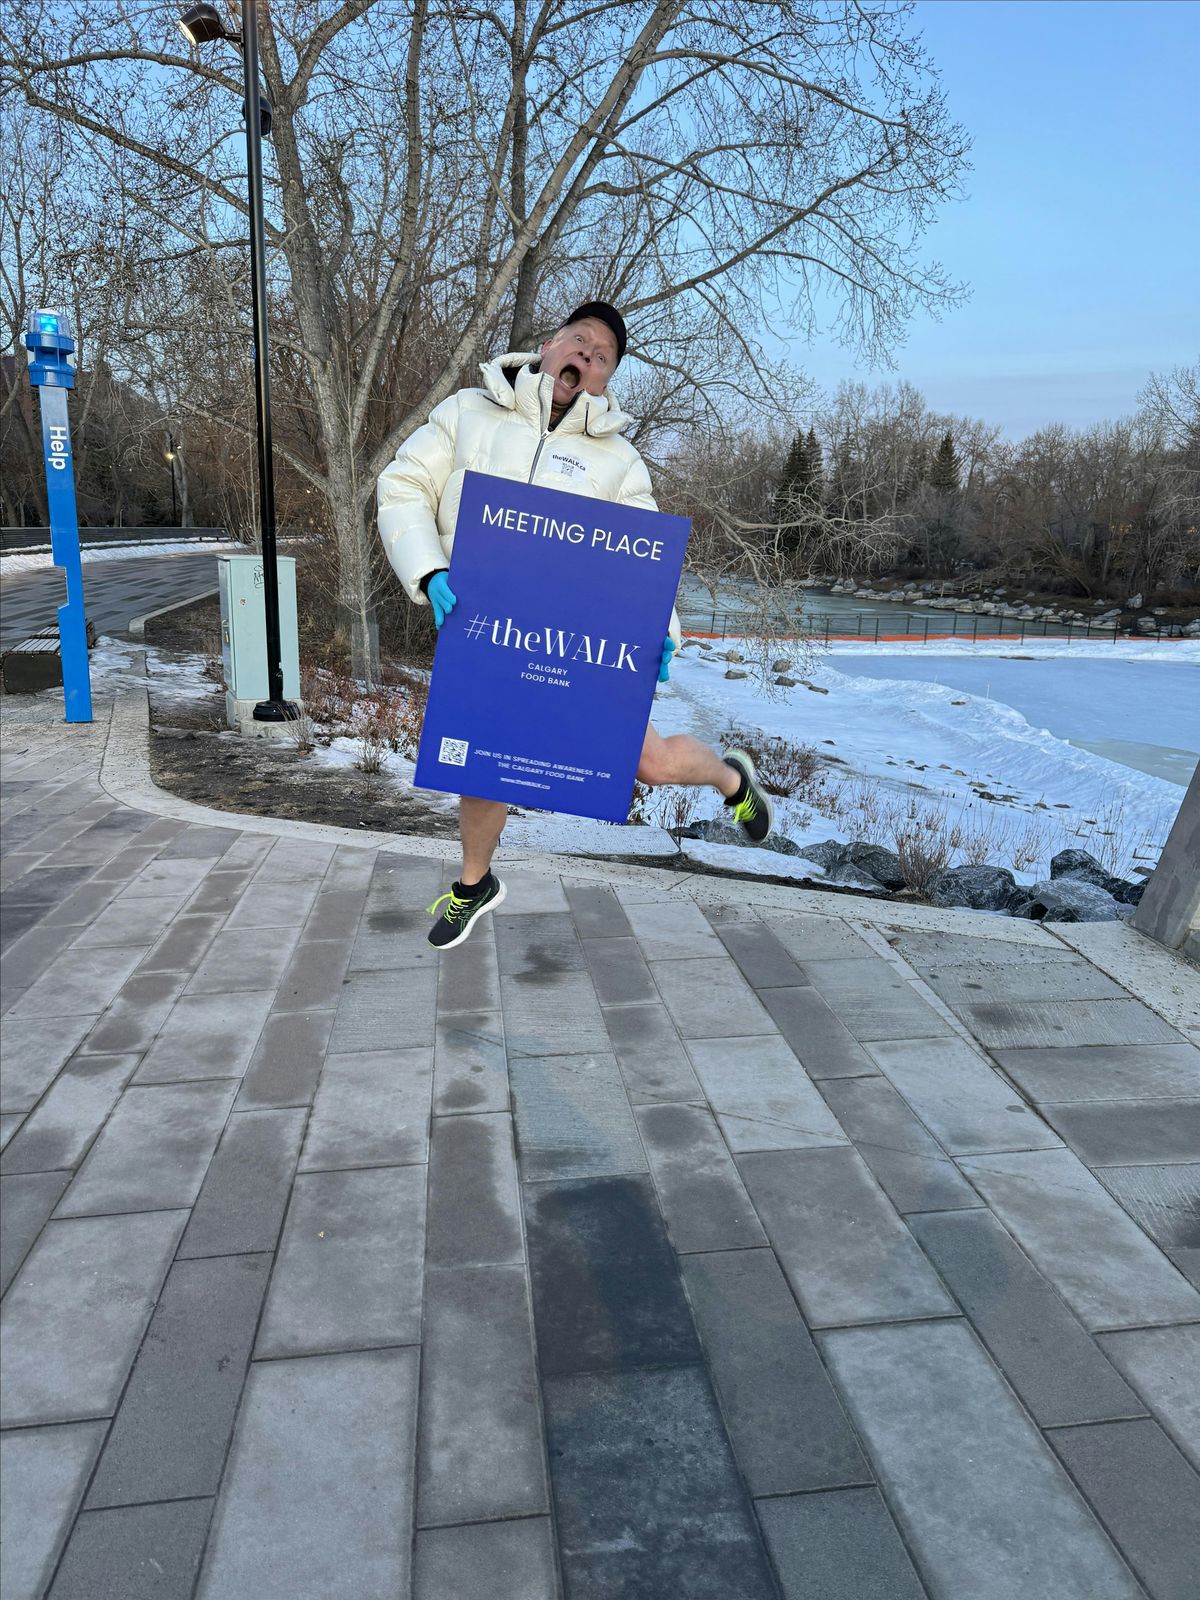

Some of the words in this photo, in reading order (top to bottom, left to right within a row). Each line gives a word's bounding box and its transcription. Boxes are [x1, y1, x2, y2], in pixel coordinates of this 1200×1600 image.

[48, 426, 68, 470] Help
[552, 454, 586, 471] theWALK.ca
[482, 504, 585, 544] MEETING
[591, 528, 664, 561] PLACE
[463, 613, 641, 673] #theWALK
[520, 671, 546, 683] FOOD
[547, 677, 571, 688] BANK
[527, 662, 568, 676] CALGARY
[474, 749, 491, 757] JOIN
[512, 756, 551, 768] SPREADING
[552, 763, 594, 776] AWARENESS
[596, 771, 611, 779] FOR
[498, 761, 510, 769] THE
[511, 764, 544, 775] CALGARY
[545, 770, 565, 779] FOOD
[566, 774, 585, 783] BANK
